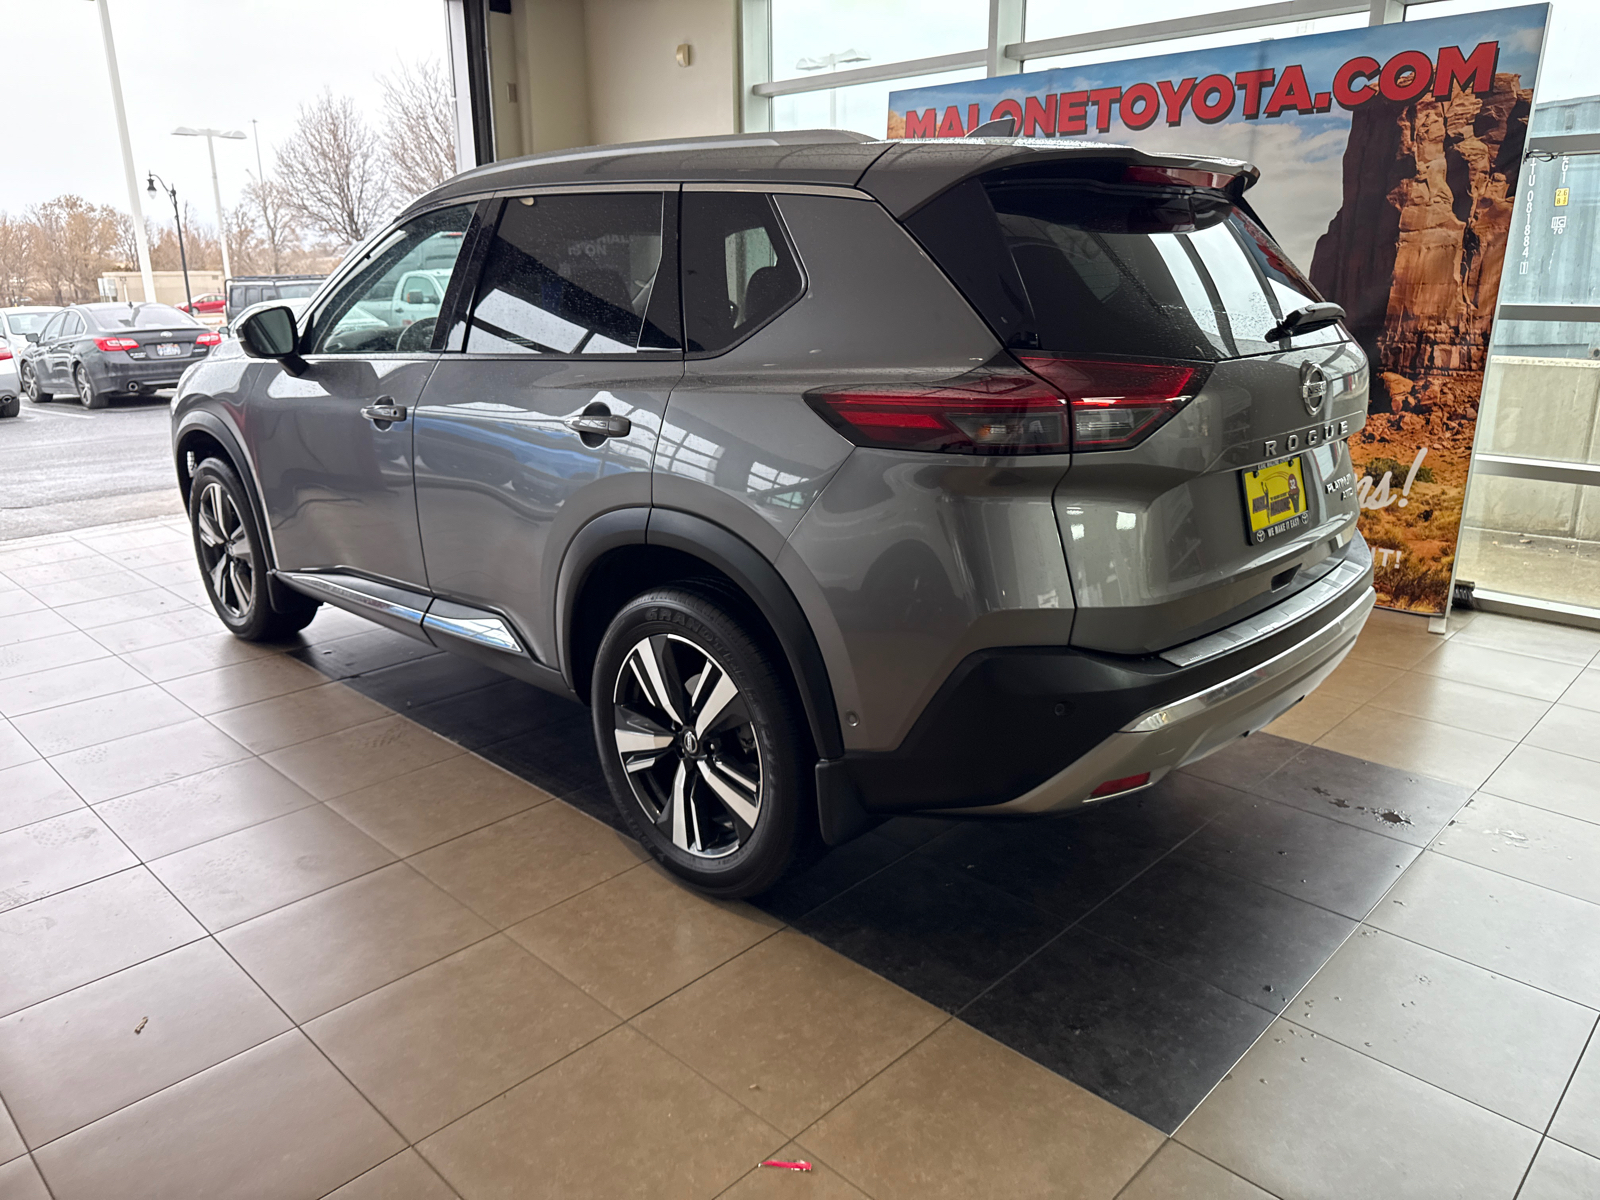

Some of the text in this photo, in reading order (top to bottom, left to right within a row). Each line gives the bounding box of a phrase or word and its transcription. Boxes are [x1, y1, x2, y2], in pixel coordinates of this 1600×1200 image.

[1265, 420, 1348, 457] ROGUE
[1267, 527, 1275, 538] WE
[1290, 517, 1300, 529] EASY
